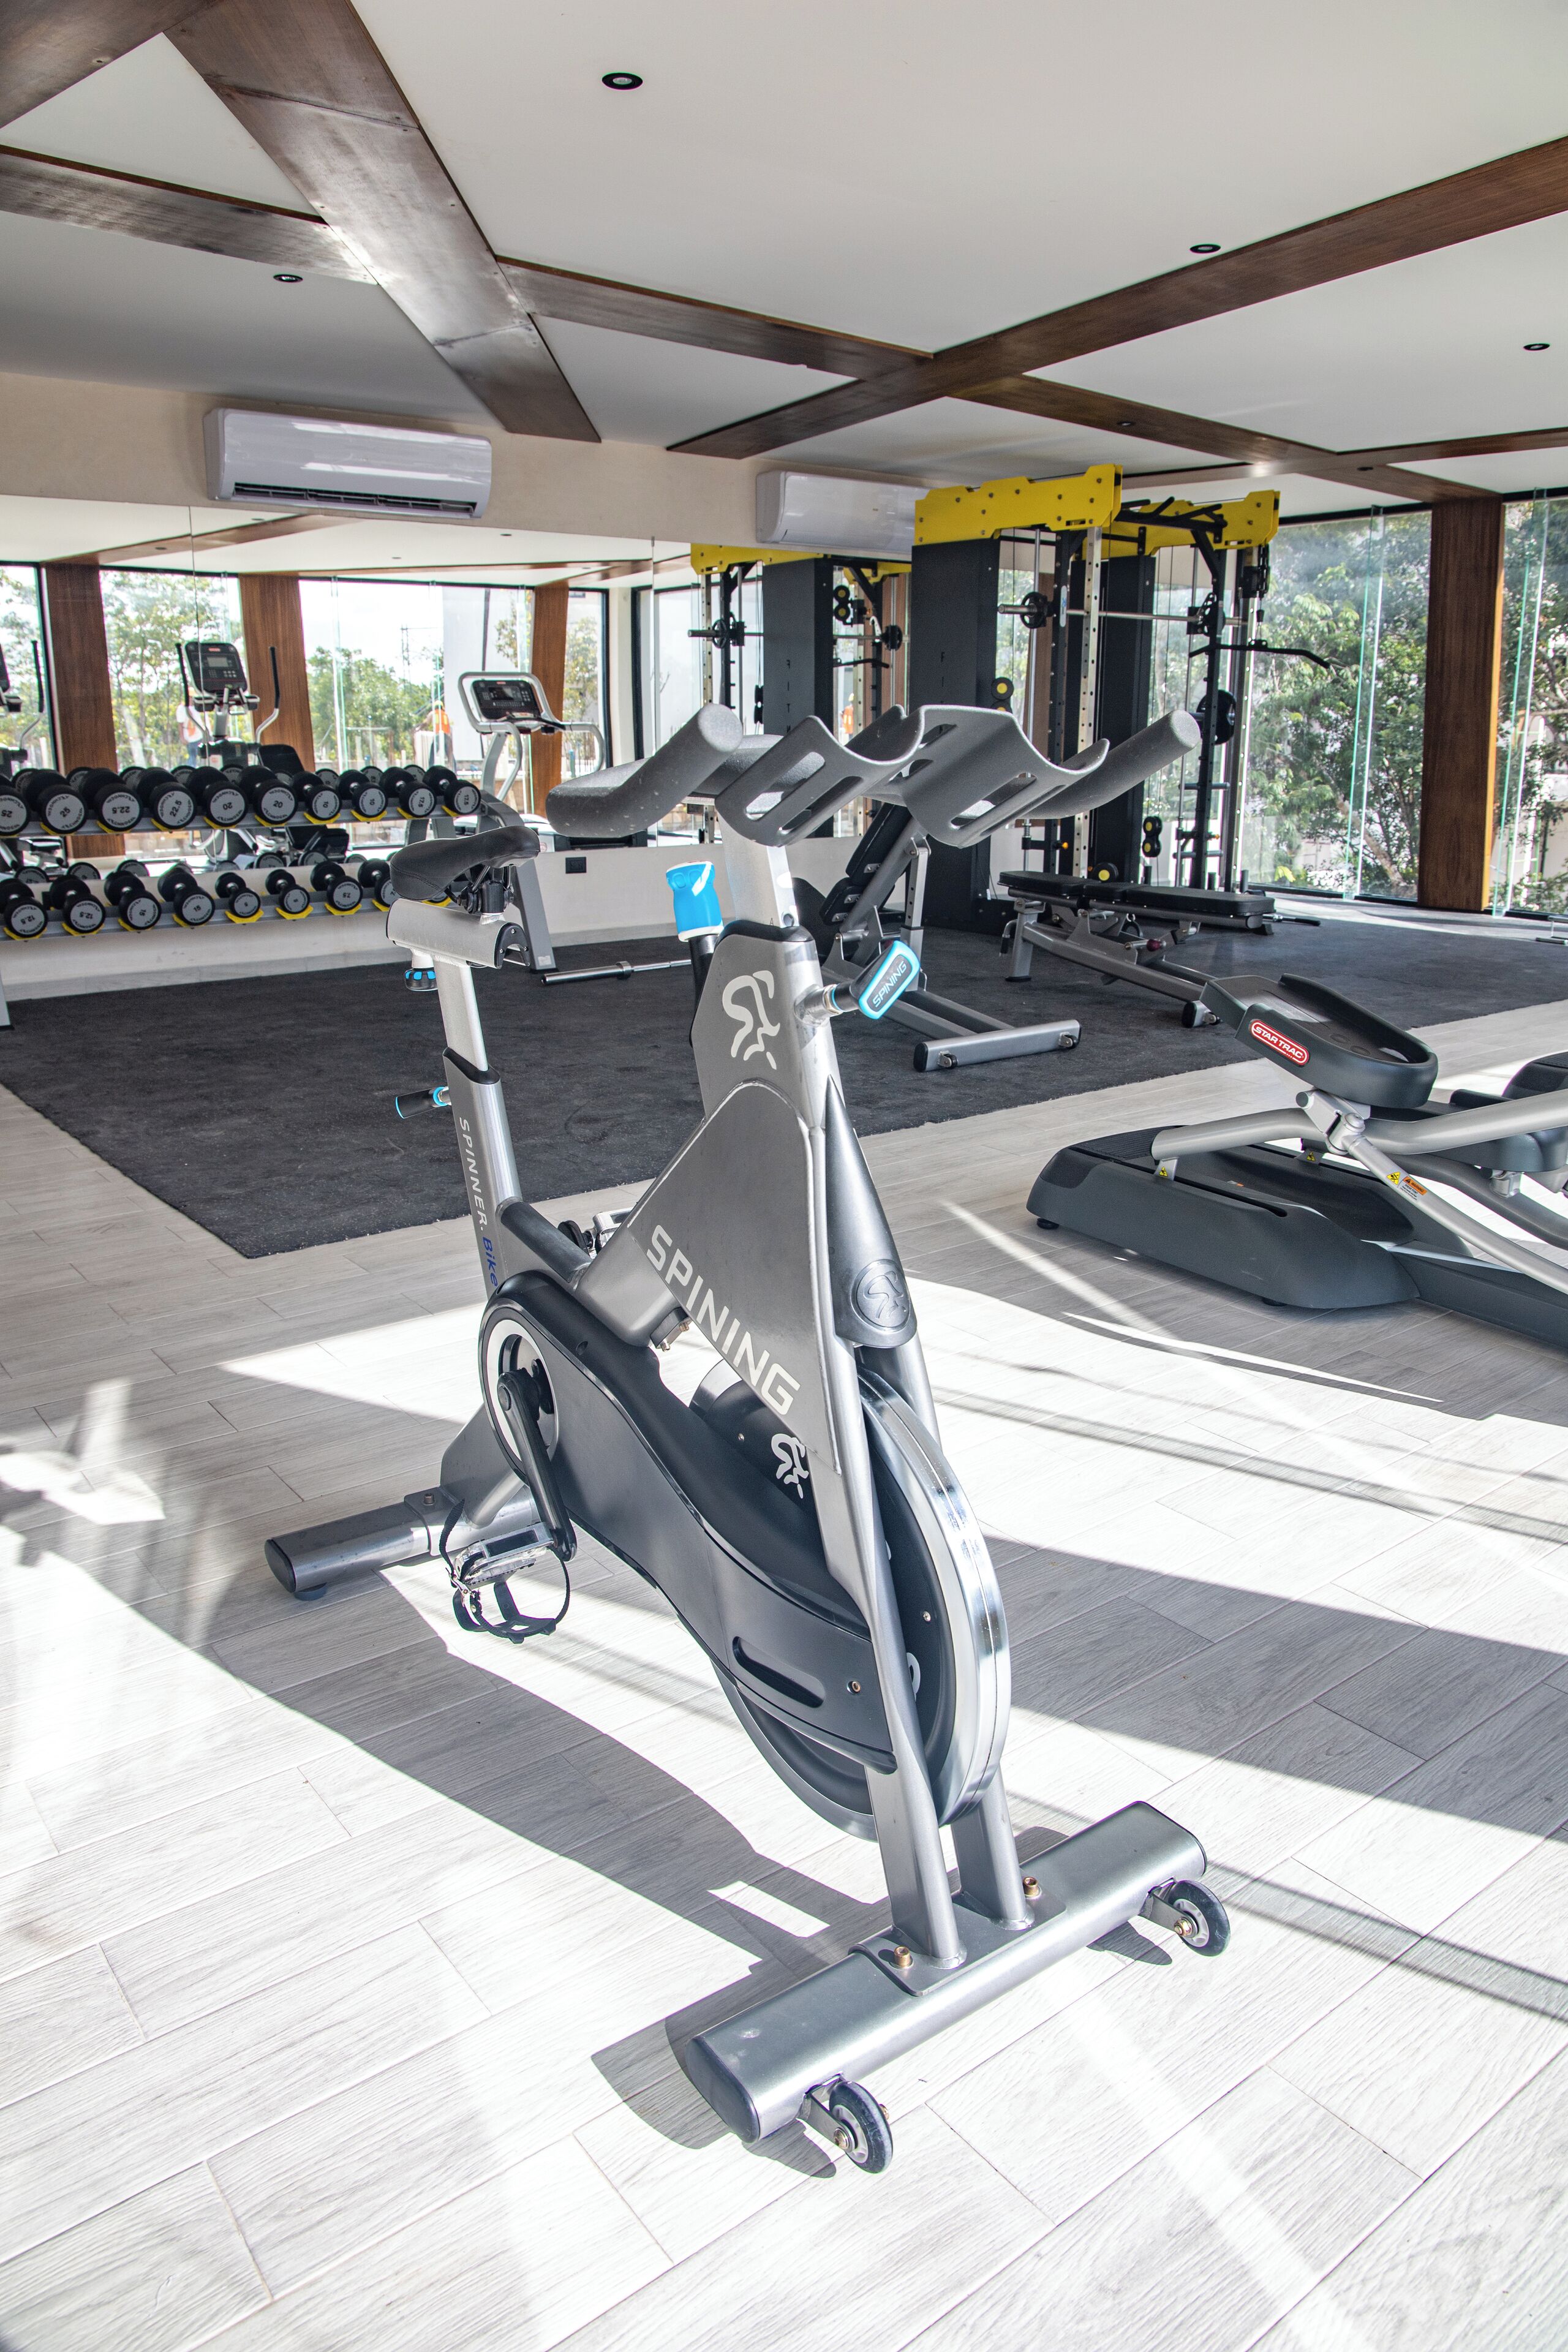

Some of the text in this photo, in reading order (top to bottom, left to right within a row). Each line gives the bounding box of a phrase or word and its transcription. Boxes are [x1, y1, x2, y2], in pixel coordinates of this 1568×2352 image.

[60, 807, 70, 817] 25
[170, 800, 182, 817] 22.5
[222, 802, 233, 810] 20
[20, 914, 36, 925] 12.5
[872, 960, 907, 1008] SPINING
[1254, 1027, 1303, 1058] STAR TRAC
[483, 1237, 498, 1287] Bike
[646, 1224, 801, 1415] SPINING
